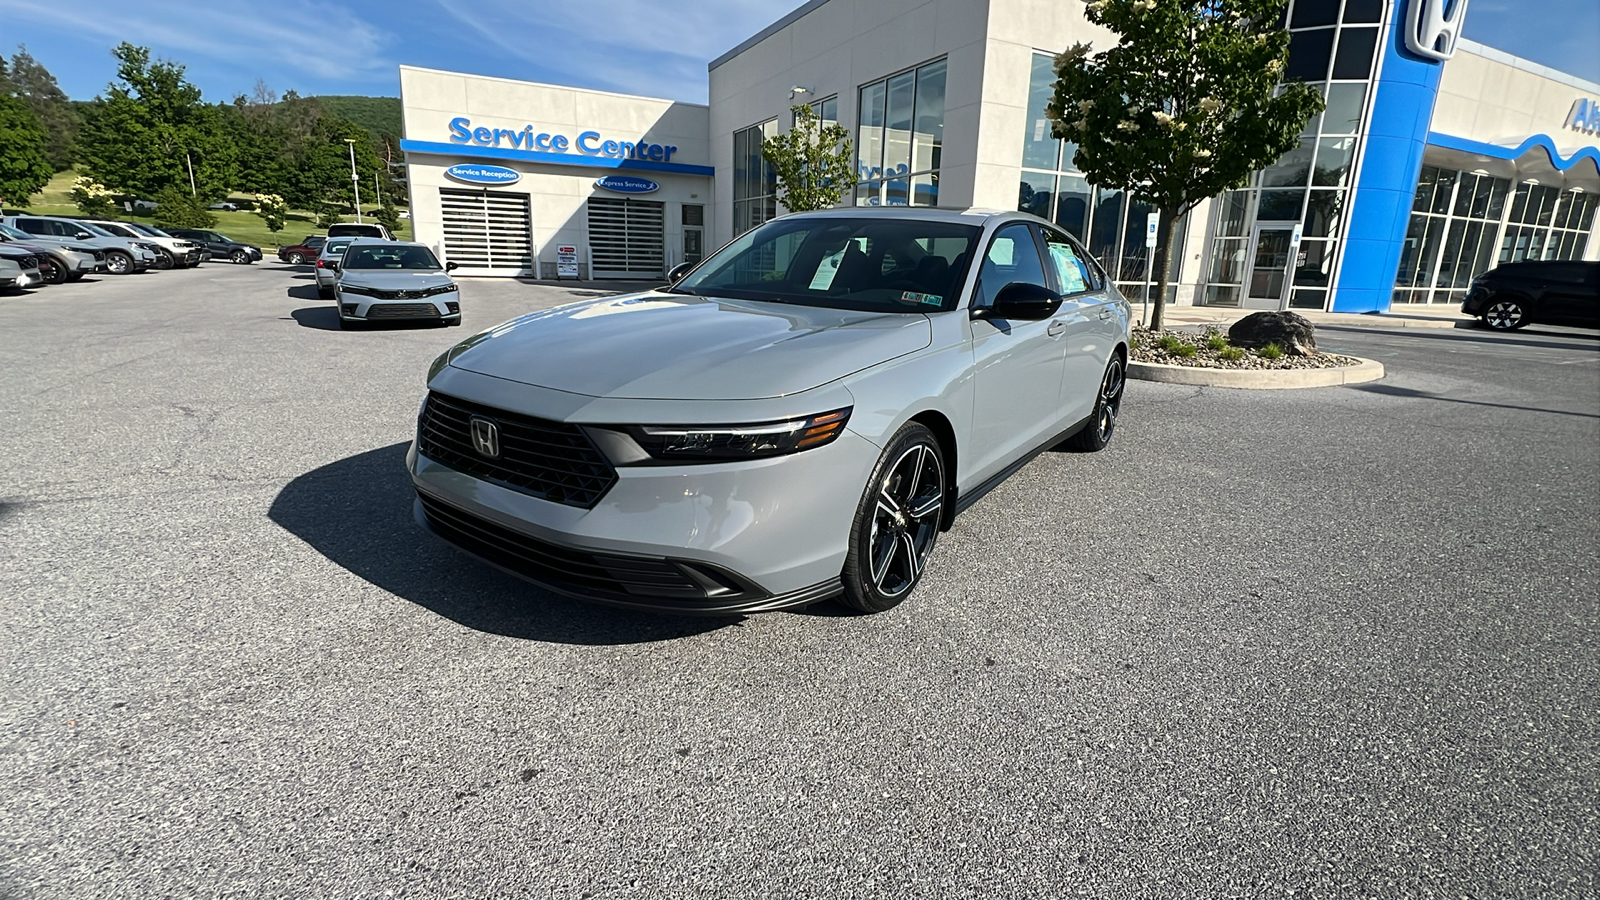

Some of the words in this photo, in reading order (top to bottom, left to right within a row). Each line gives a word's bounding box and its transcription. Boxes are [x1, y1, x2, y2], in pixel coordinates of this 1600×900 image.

[449, 117, 569, 152] Service
[576, 131, 678, 162] Center
[452, 167, 480, 176] Service
[481, 169, 517, 179] Reception
[600, 179, 624, 187] Express
[624, 180, 647, 189] Service
